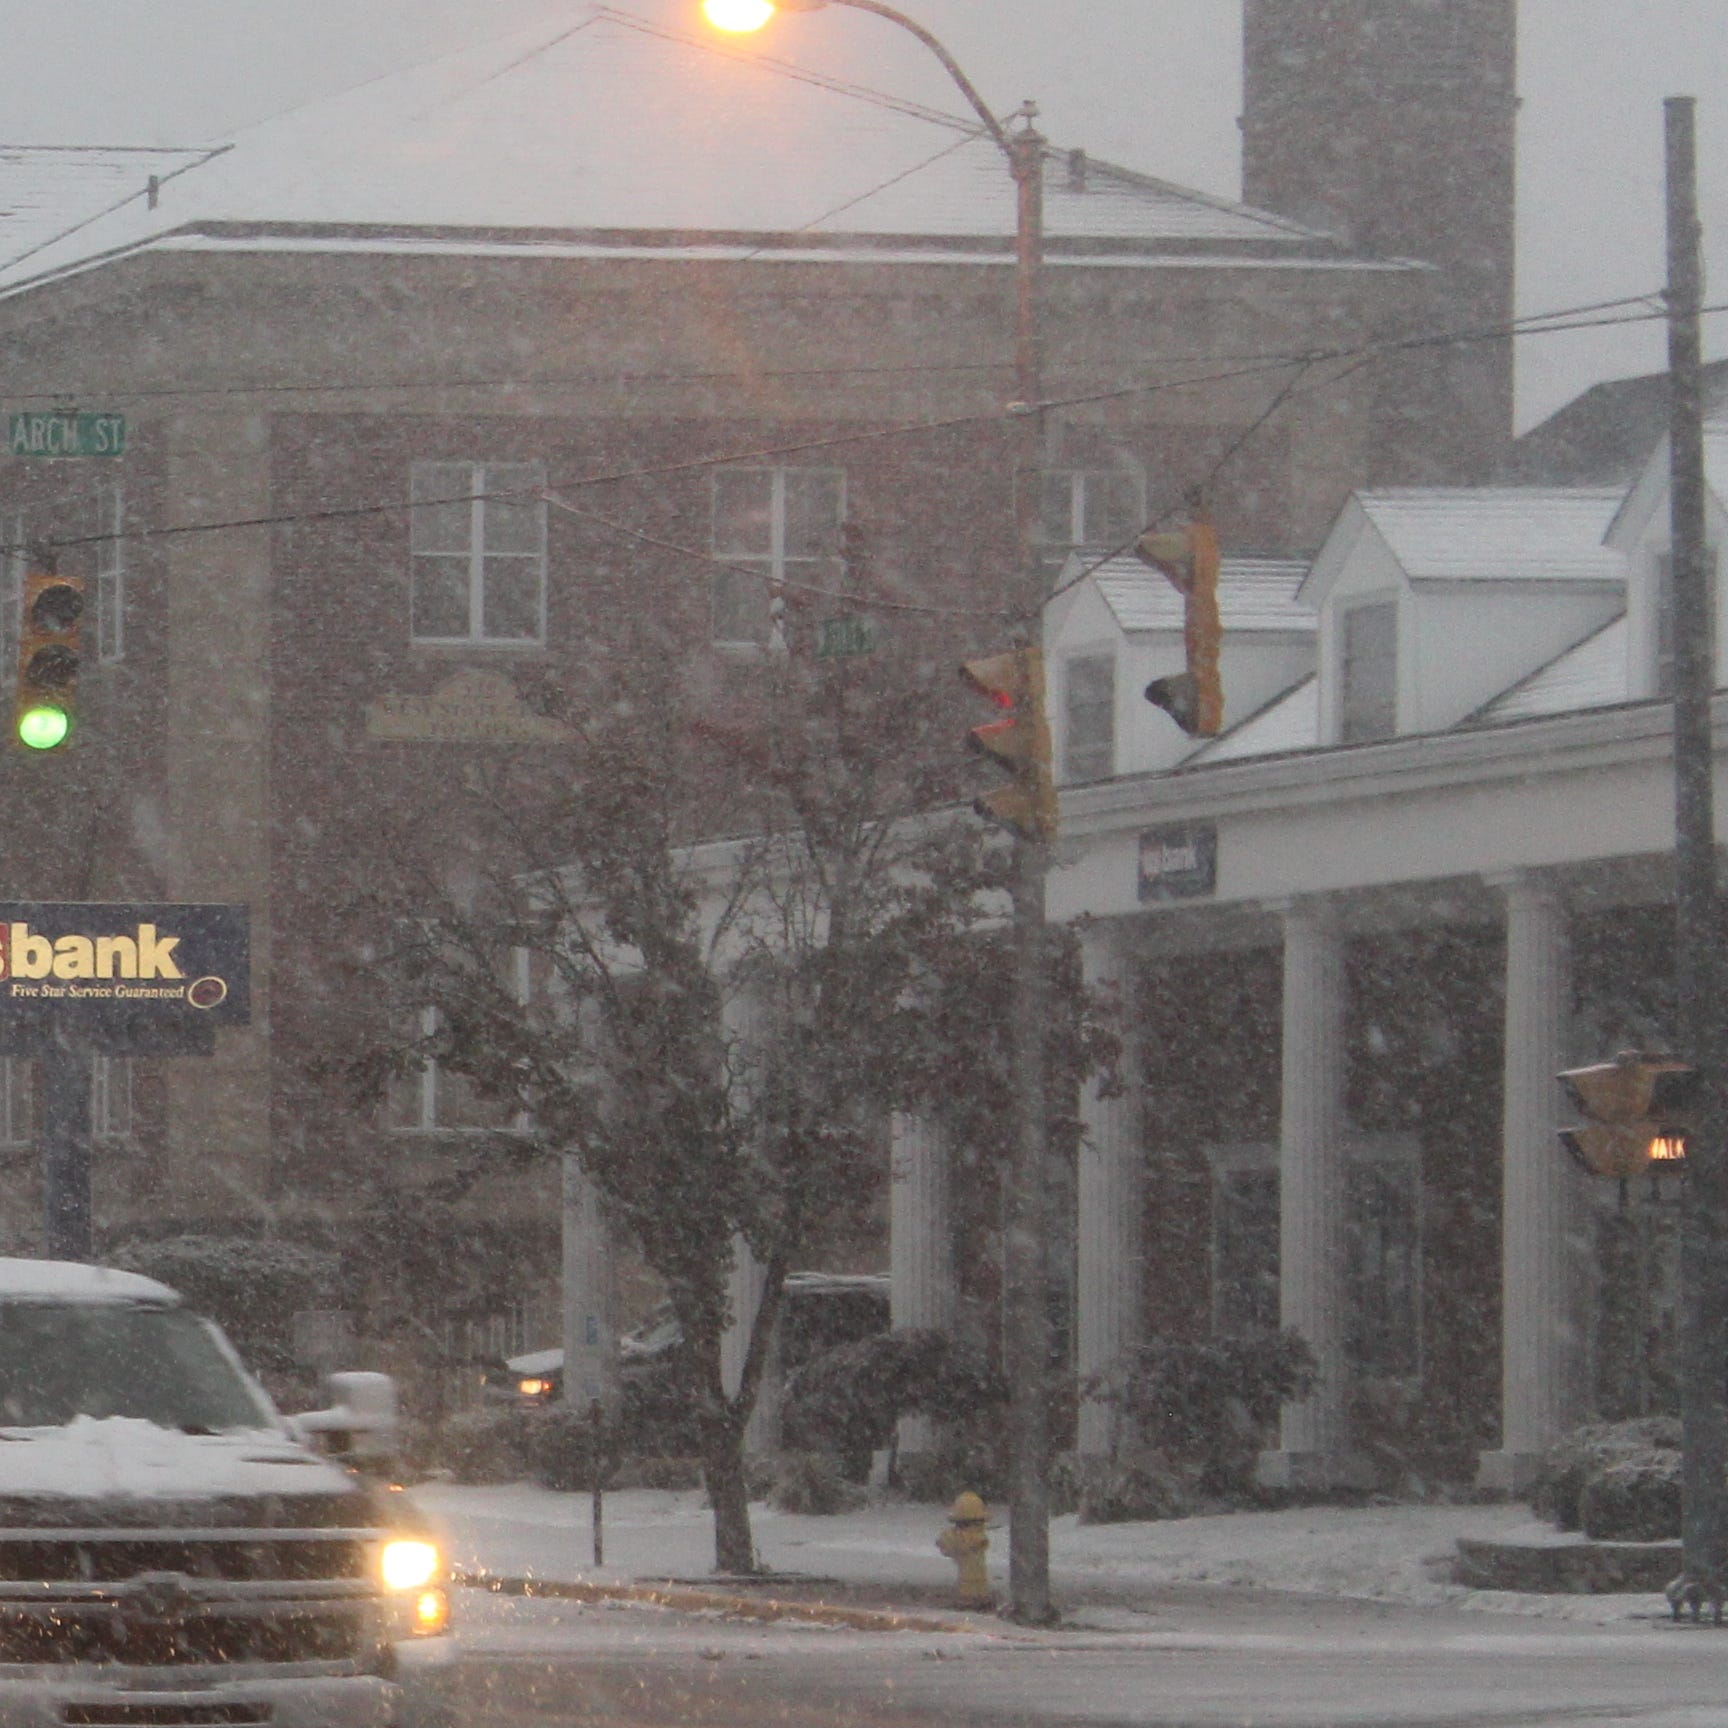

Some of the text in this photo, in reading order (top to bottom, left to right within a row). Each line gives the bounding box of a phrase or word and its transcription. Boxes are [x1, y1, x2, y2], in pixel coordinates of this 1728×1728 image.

[13, 417, 123, 452] ARCH ST
[11, 984, 185, 999] Five Star Service Guaranteed
